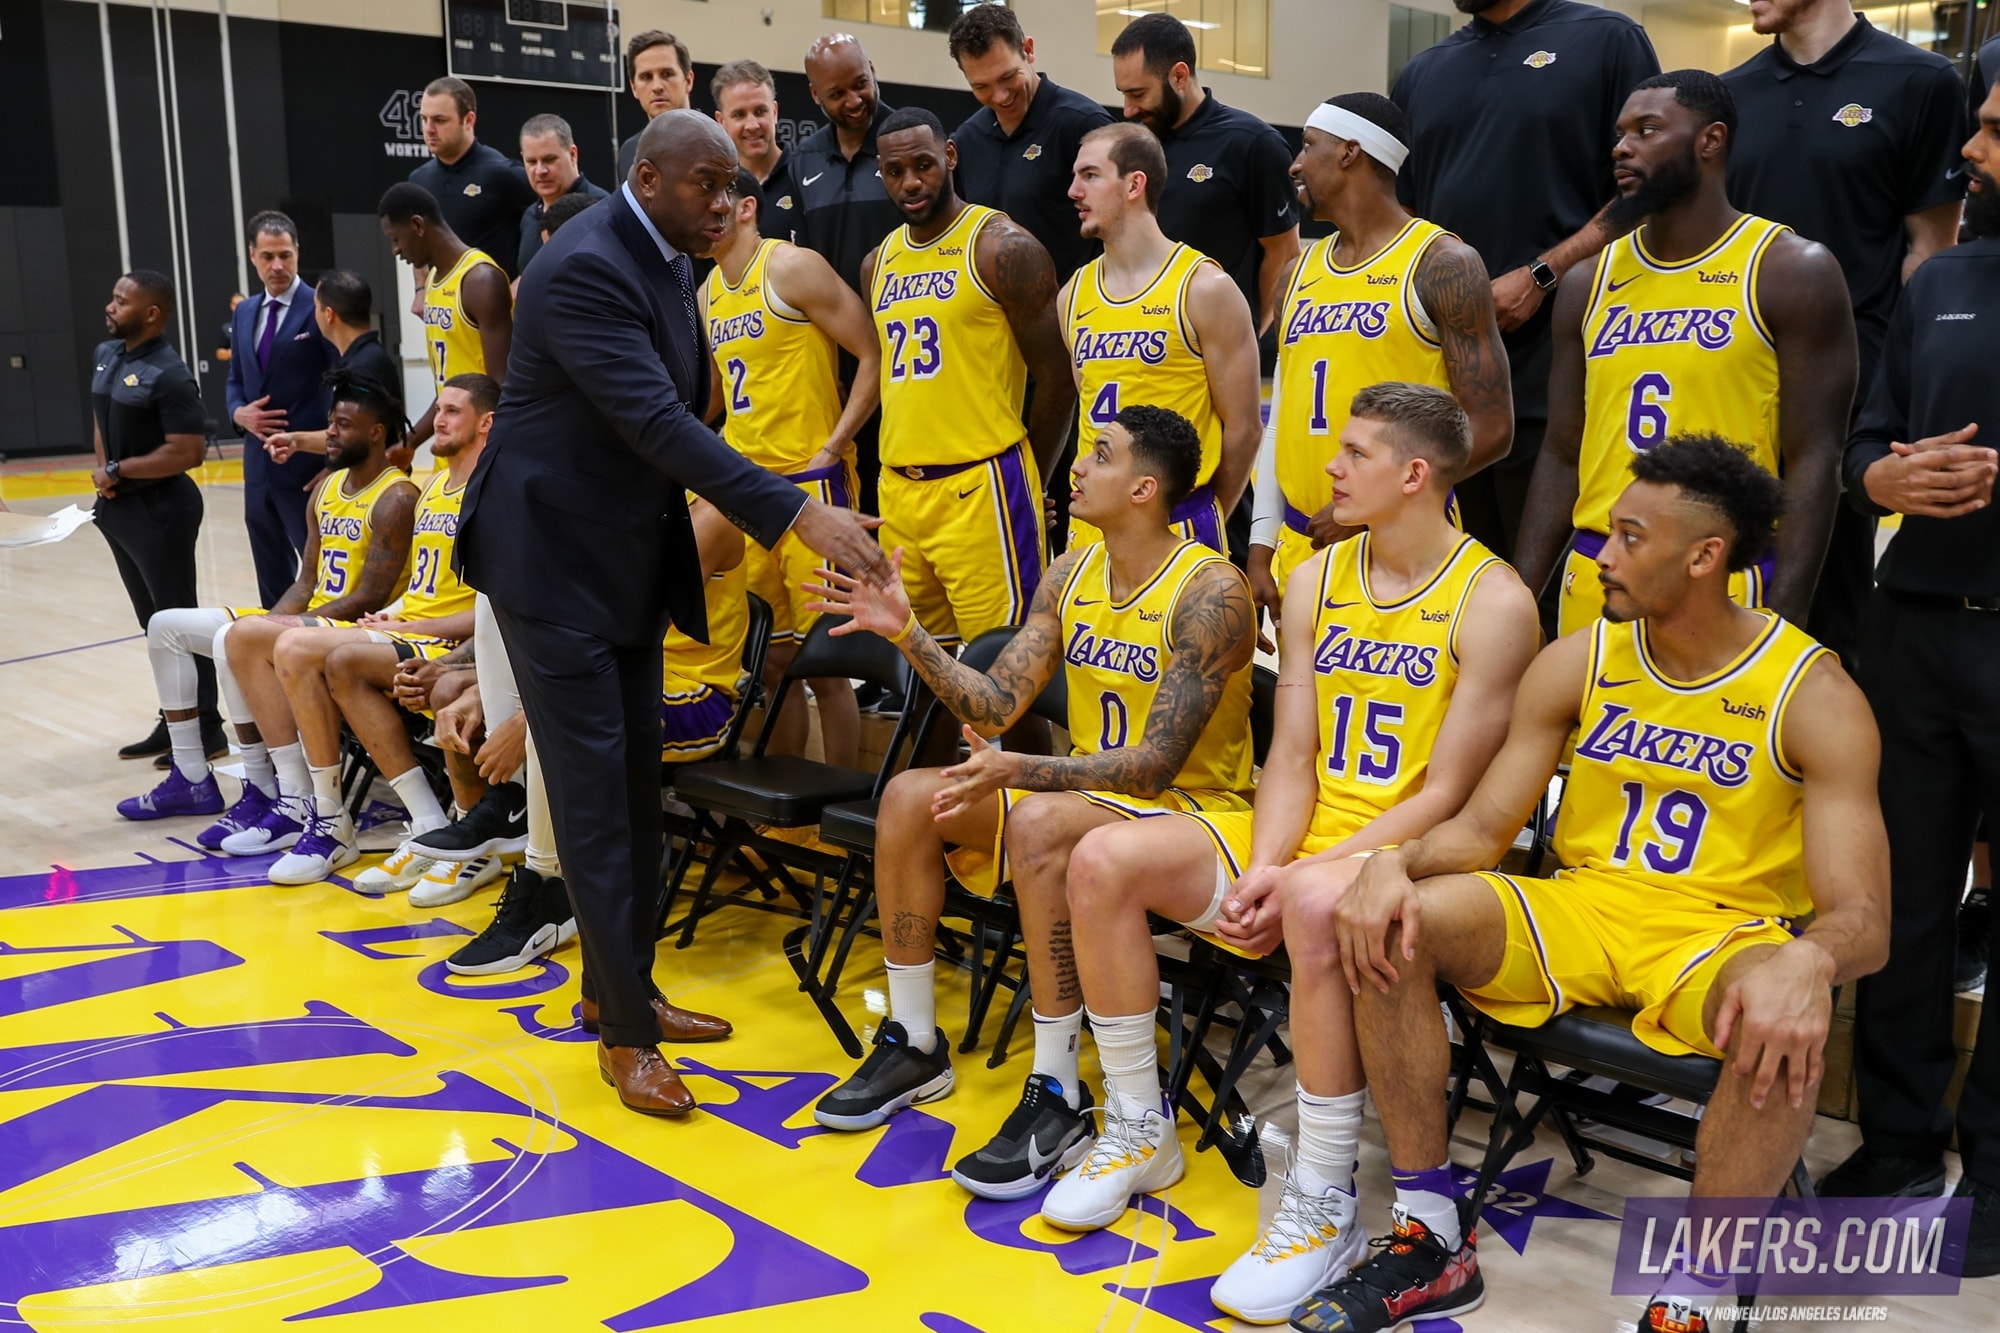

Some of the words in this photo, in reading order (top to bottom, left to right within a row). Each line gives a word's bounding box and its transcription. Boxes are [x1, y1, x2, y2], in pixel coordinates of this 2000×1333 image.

[384, 142, 436, 158] WORTH
[938, 247, 962, 256] wish
[874, 269, 959, 313] LAKERS
[1367, 274, 1398, 285] wish
[1697, 271, 1738, 284] wish
[709, 309, 766, 353] LAKERS
[1141, 304, 1171, 316] wish
[1284, 298, 1392, 346] LAKERS
[1587, 304, 1739, 360] LAKERS
[886, 316, 943, 383] 23
[1074, 327, 1169, 370] LAKERS
[726, 357, 753, 416] 2
[1088, 381, 1121, 428] 4
[1309, 358, 1329, 435] 1
[1626, 371, 1673, 456] 6
[412, 508, 460, 537] LAKERS
[409, 546, 440, 598] 31
[1138, 608, 1163, 622] wish
[1420, 609, 1450, 623] wish
[1064, 622, 1161, 684] LAKERS
[1314, 625, 1440, 688] LAKERS
[1099, 690, 1129, 751] 0
[1720, 697, 1766, 722] wish
[1326, 693, 1405, 787] 15
[1574, 702, 1756, 788] LAKERS
[1608, 781, 1710, 875] 19
